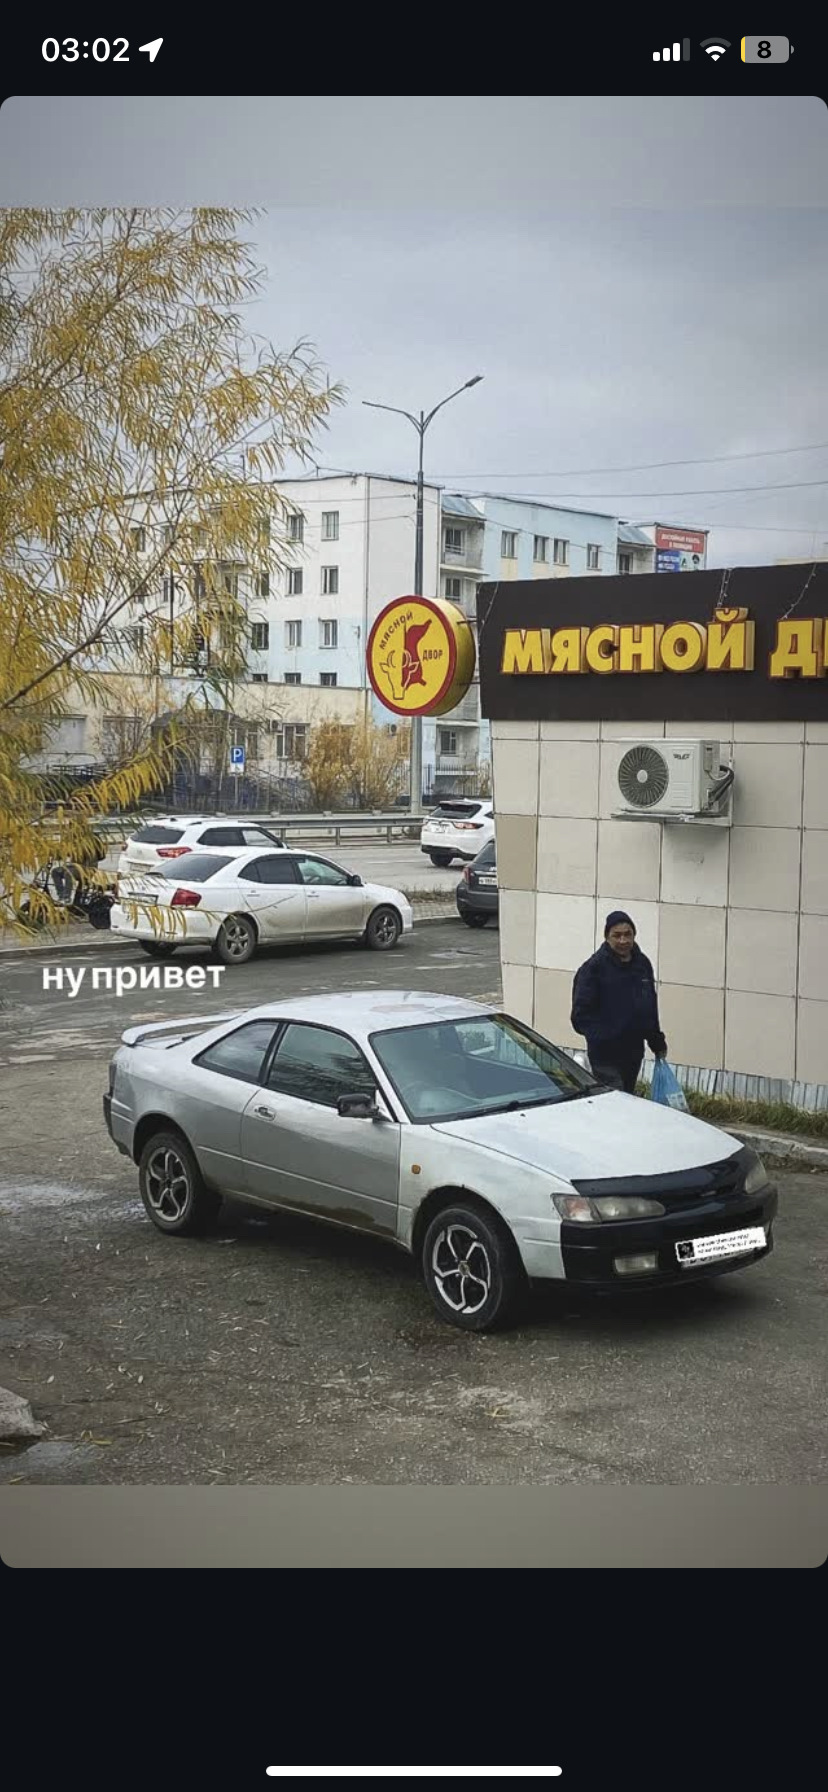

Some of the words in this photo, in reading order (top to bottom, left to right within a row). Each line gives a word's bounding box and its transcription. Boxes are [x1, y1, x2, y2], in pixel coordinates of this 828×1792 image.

[501, 608, 755, 675] МЯСНОЙ
[768, 618, 828, 679] Д
[422, 649, 443, 661] ДВОР
[233, 748, 242, 762] P
